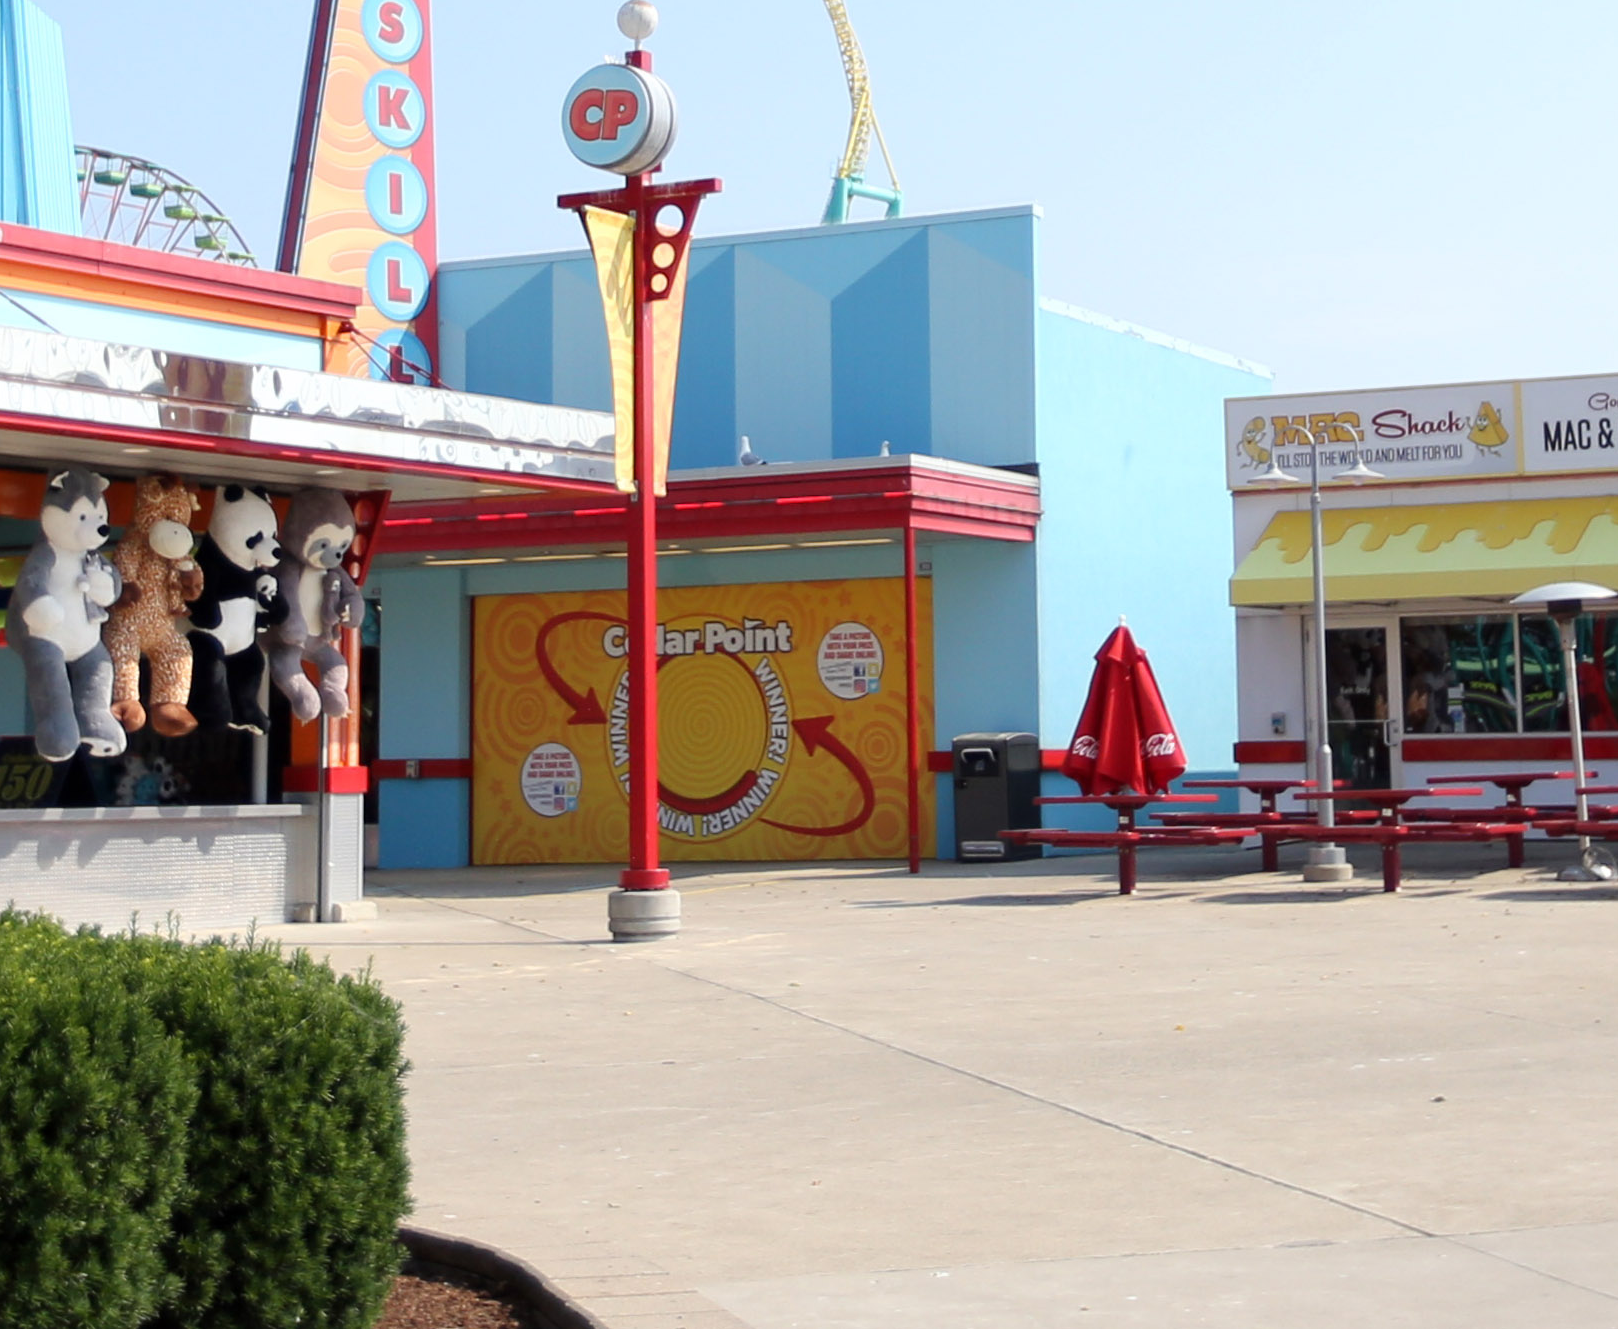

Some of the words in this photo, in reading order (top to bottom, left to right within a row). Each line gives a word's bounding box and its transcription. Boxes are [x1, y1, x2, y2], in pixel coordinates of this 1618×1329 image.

[569, 87, 638, 141] CP
[376, 0, 414, 385] SKILL
[1271, 411, 1365, 447] MAC
[1371, 409, 1467, 439] Shack
[1543, 419, 1592, 452] MAC
[1598, 418, 1615, 449] &
[1294, 452, 1312, 467] STO
[1319, 451, 1337, 465] THE
[1338, 448, 1373, 465] WOLD
[1375, 448, 1394, 462] AND
[1396, 446, 1420, 462] MELT
[1423, 444, 1441, 460] FOR
[1442, 443, 1462, 459] YOU
[603, 624, 700, 658] Car
[704, 616, 793, 655] Point
[754, 656, 789, 765] WINNER!
[701, 768, 780, 836] WINNER!
